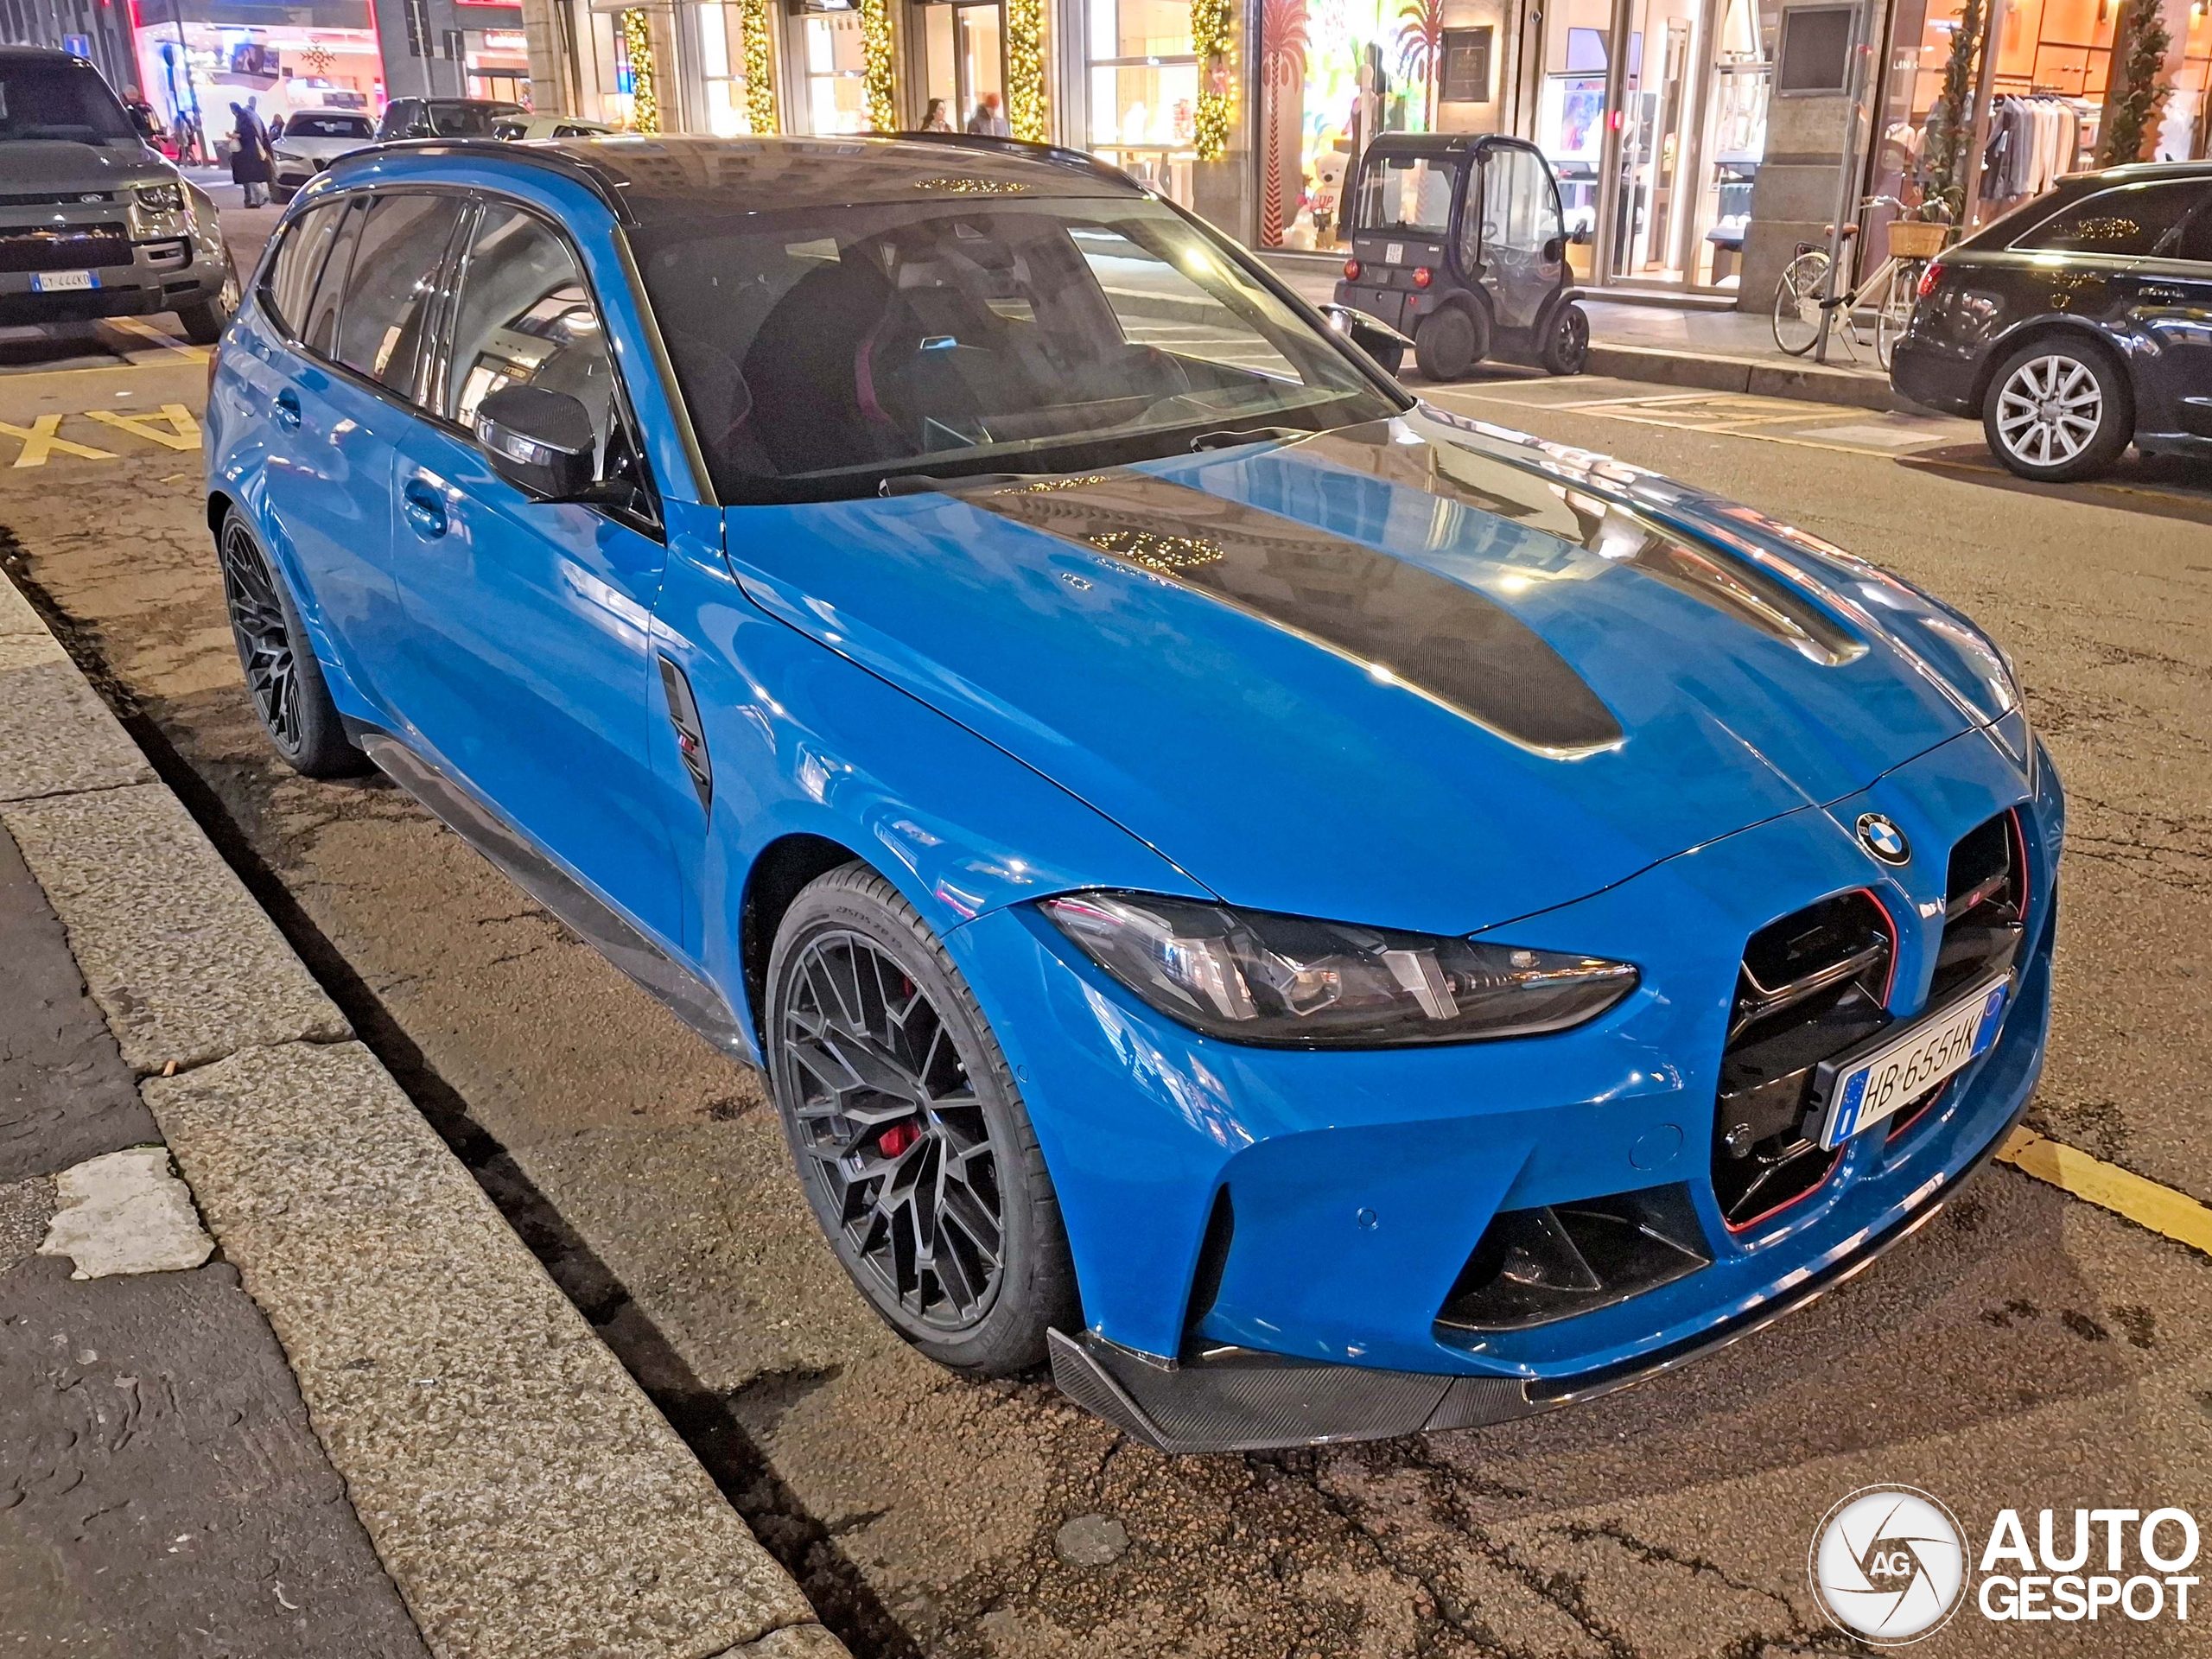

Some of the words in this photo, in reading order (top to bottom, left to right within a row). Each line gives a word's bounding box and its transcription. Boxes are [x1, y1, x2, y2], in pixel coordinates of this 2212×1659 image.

[1859, 814, 1891, 836] BMW
[1860, 1064, 1898, 1118] HB
[1903, 1009, 1982, 1091] 655HK
